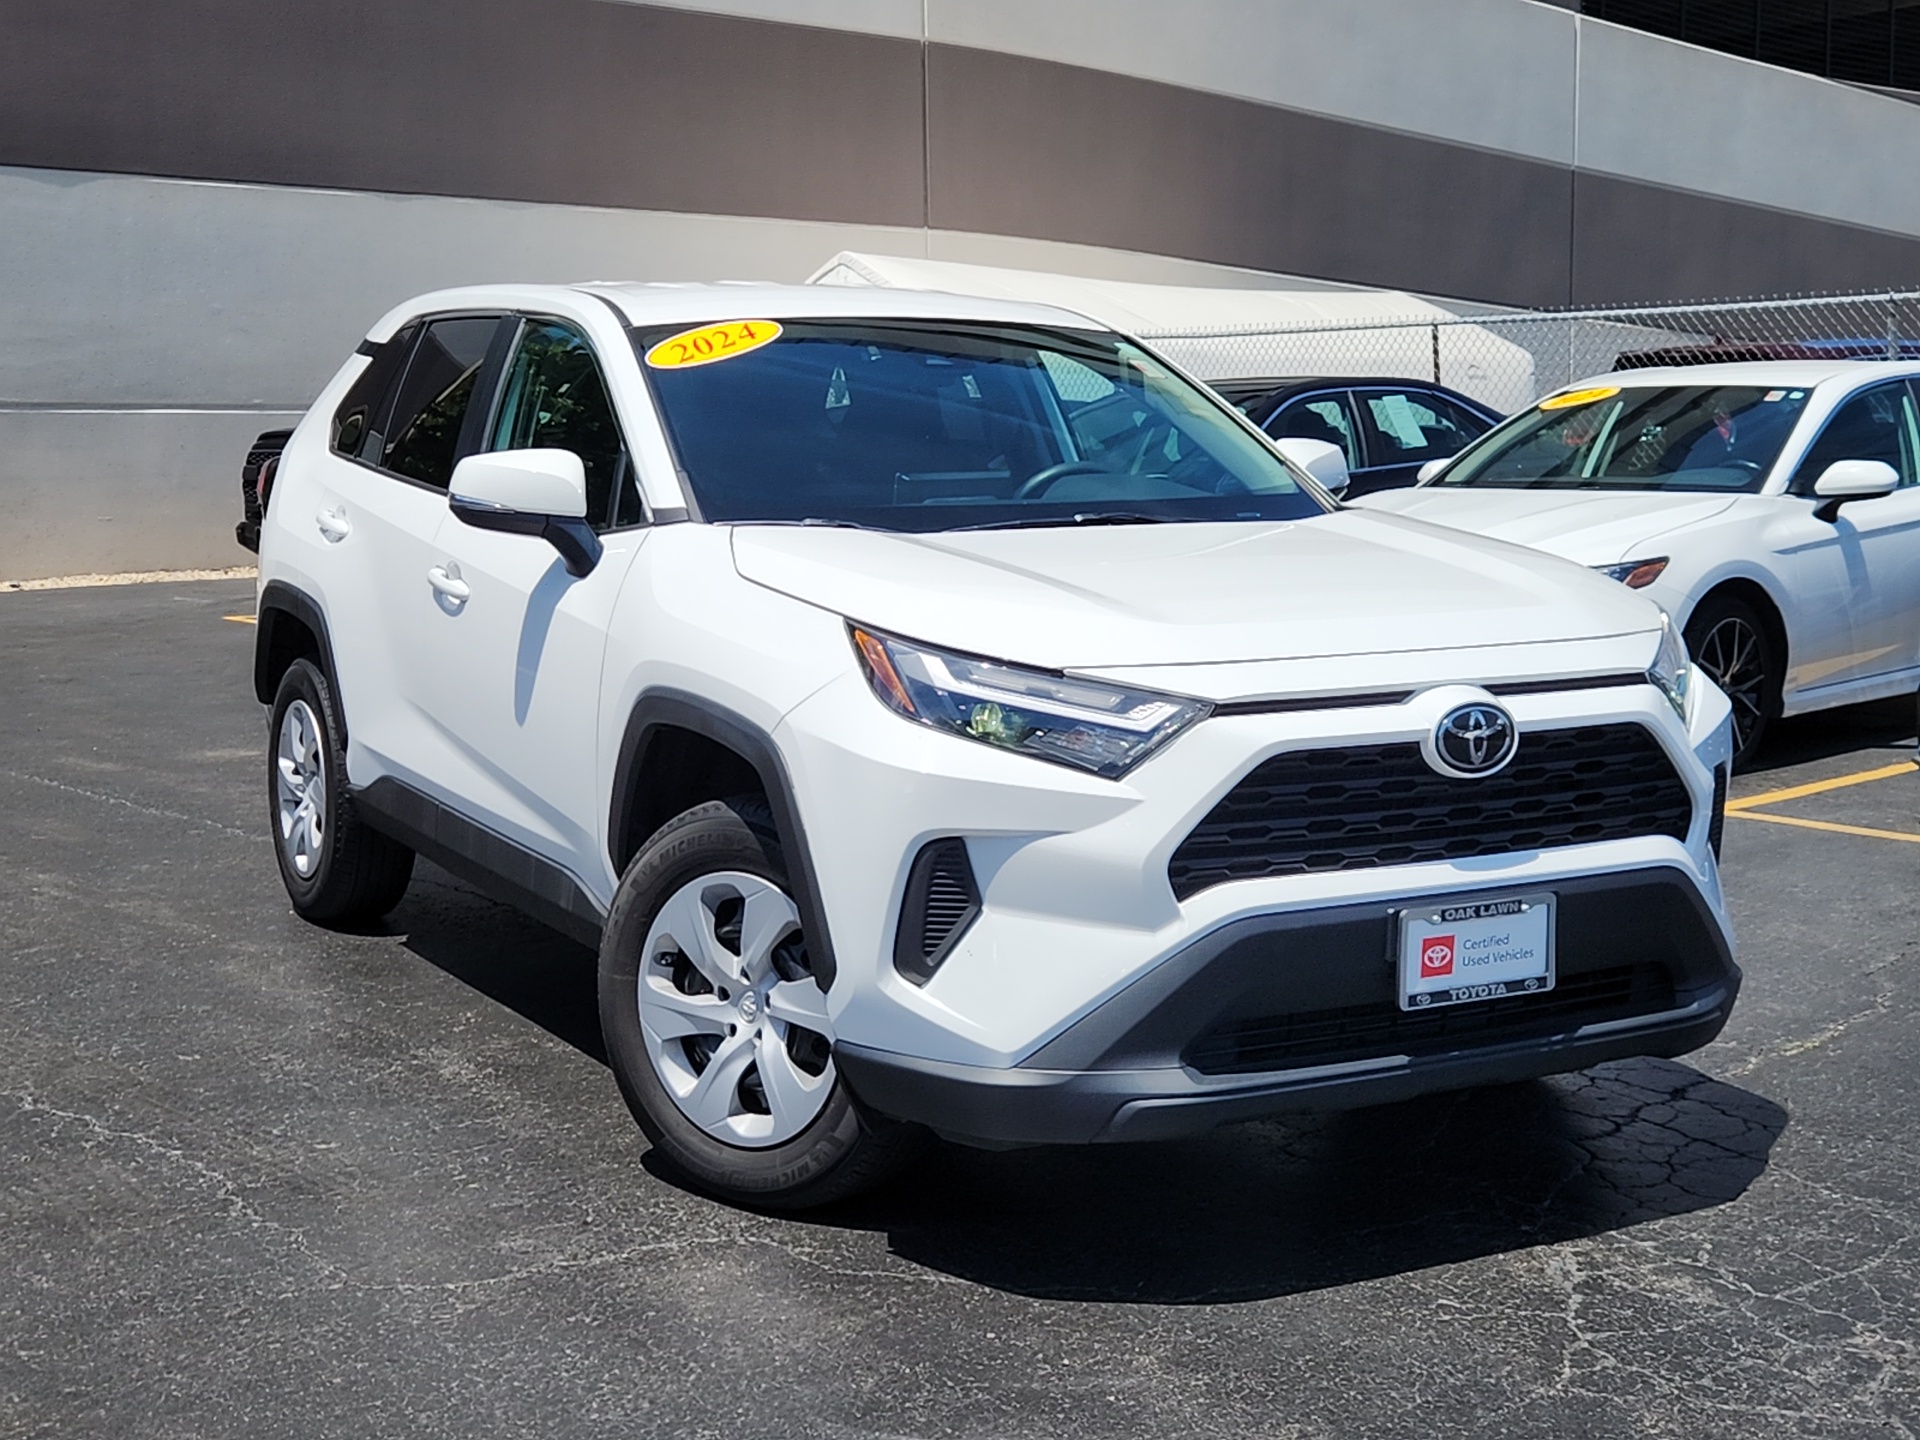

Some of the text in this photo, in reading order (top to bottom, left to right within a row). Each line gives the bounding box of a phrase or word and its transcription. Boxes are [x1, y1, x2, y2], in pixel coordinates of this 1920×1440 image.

[670, 323, 757, 364] 2024
[1444, 901, 1520, 921] OAK LAWN
[1463, 934, 1510, 950] Certified
[1462, 948, 1534, 968] Used Vehicles
[1449, 983, 1507, 1001] TOYOTA
